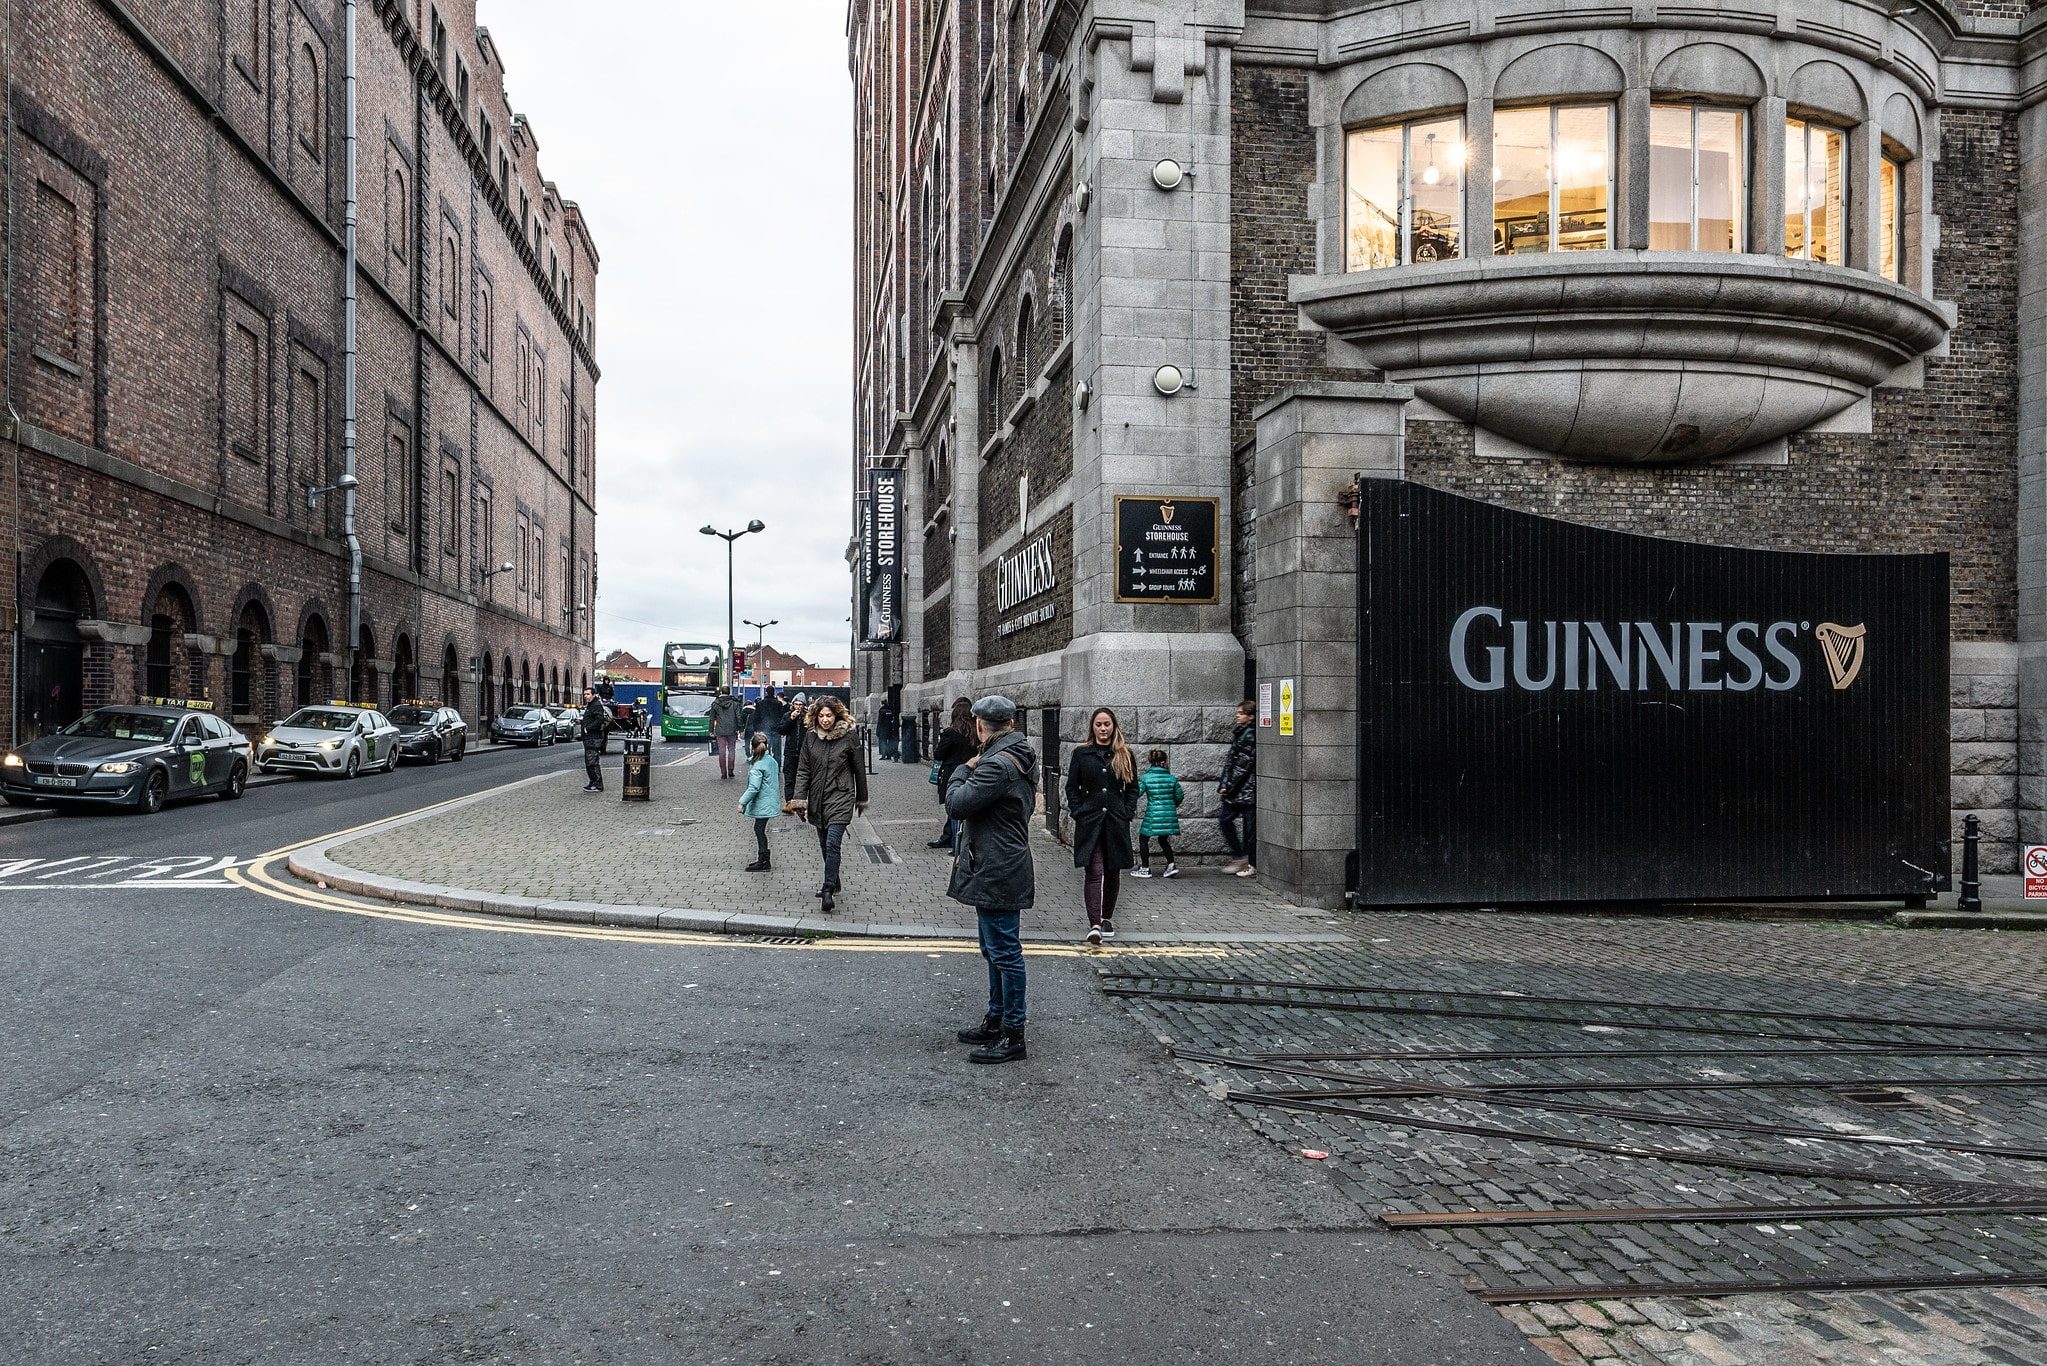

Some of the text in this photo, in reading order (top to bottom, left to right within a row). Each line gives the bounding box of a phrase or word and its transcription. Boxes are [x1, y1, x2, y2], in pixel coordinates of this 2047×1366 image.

[1152, 523, 1182, 531] GUINNESS
[1145, 531, 1189, 541] STOREHOUSE
[877, 477, 895, 622] GUINNESS STOREHOUSE
[167, 698, 185, 706] TAXI
